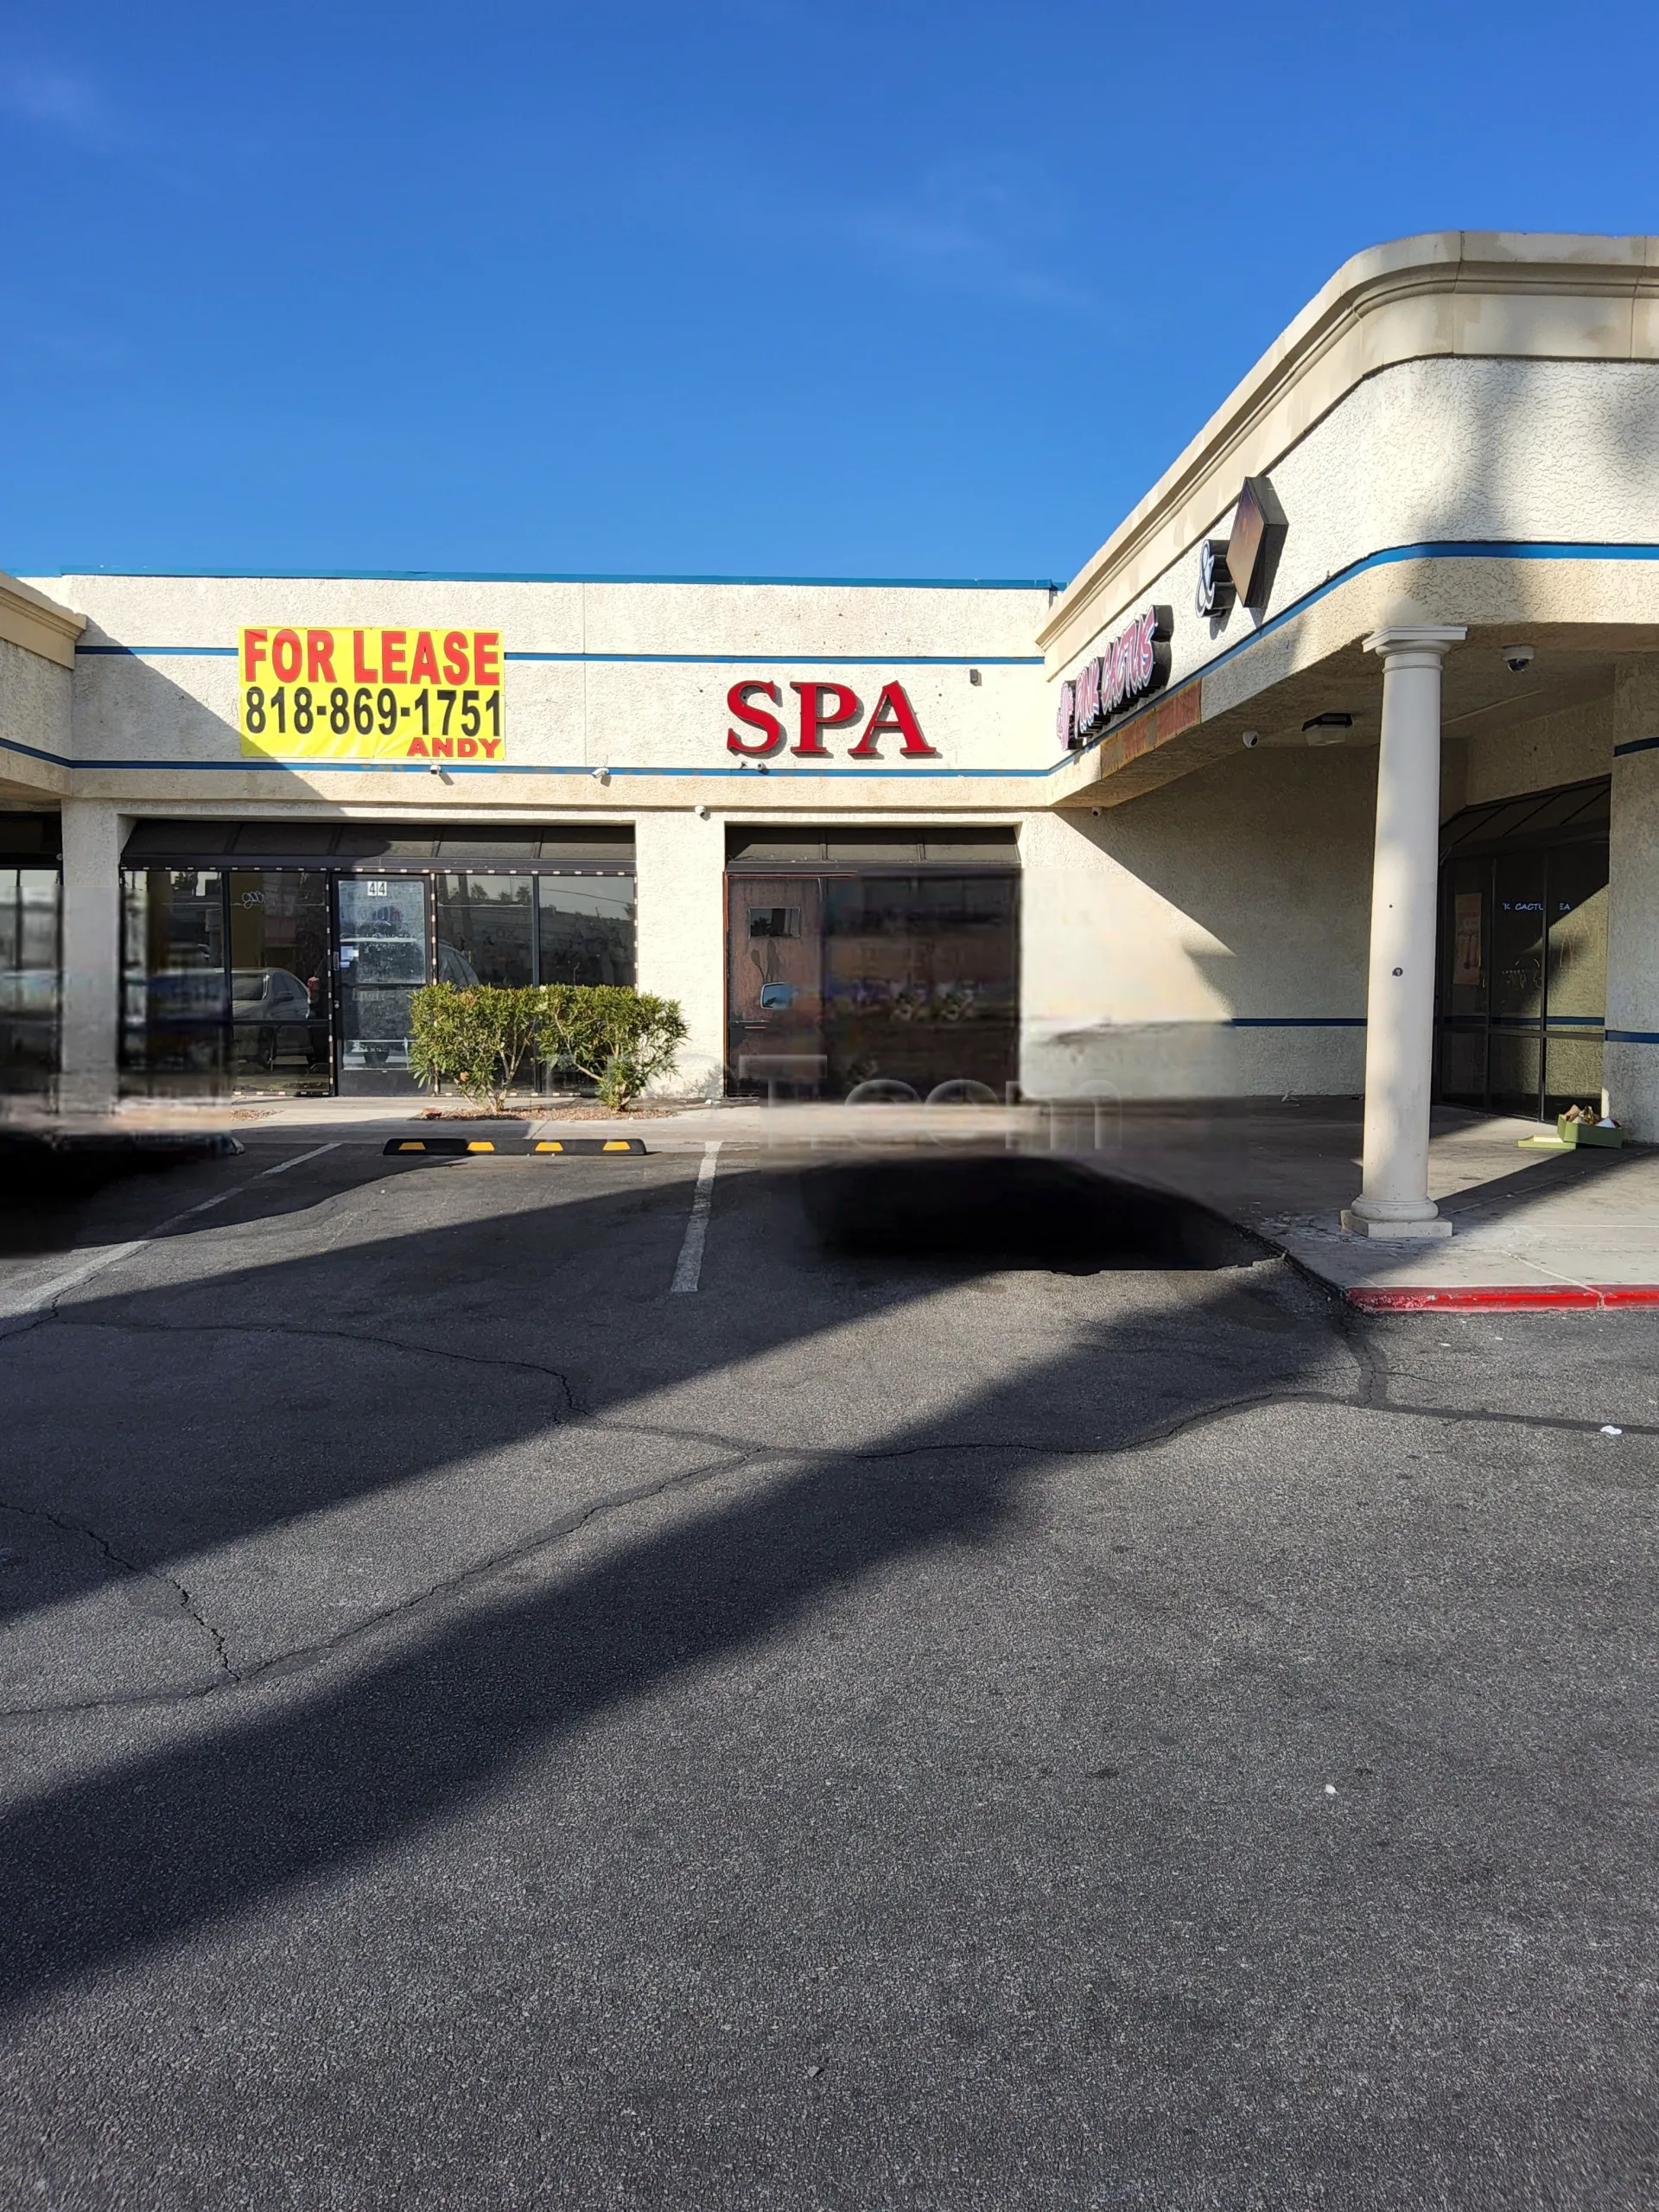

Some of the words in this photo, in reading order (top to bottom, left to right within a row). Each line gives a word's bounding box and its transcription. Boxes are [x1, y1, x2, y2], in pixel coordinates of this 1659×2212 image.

[245, 628, 338, 683] FOR
[353, 630, 500, 686] LEASE
[245, 685, 501, 737] 818-869-1751
[727, 680, 937, 754] SPA
[406, 737, 502, 758] ANDY
[369, 881, 386, 895] 44
